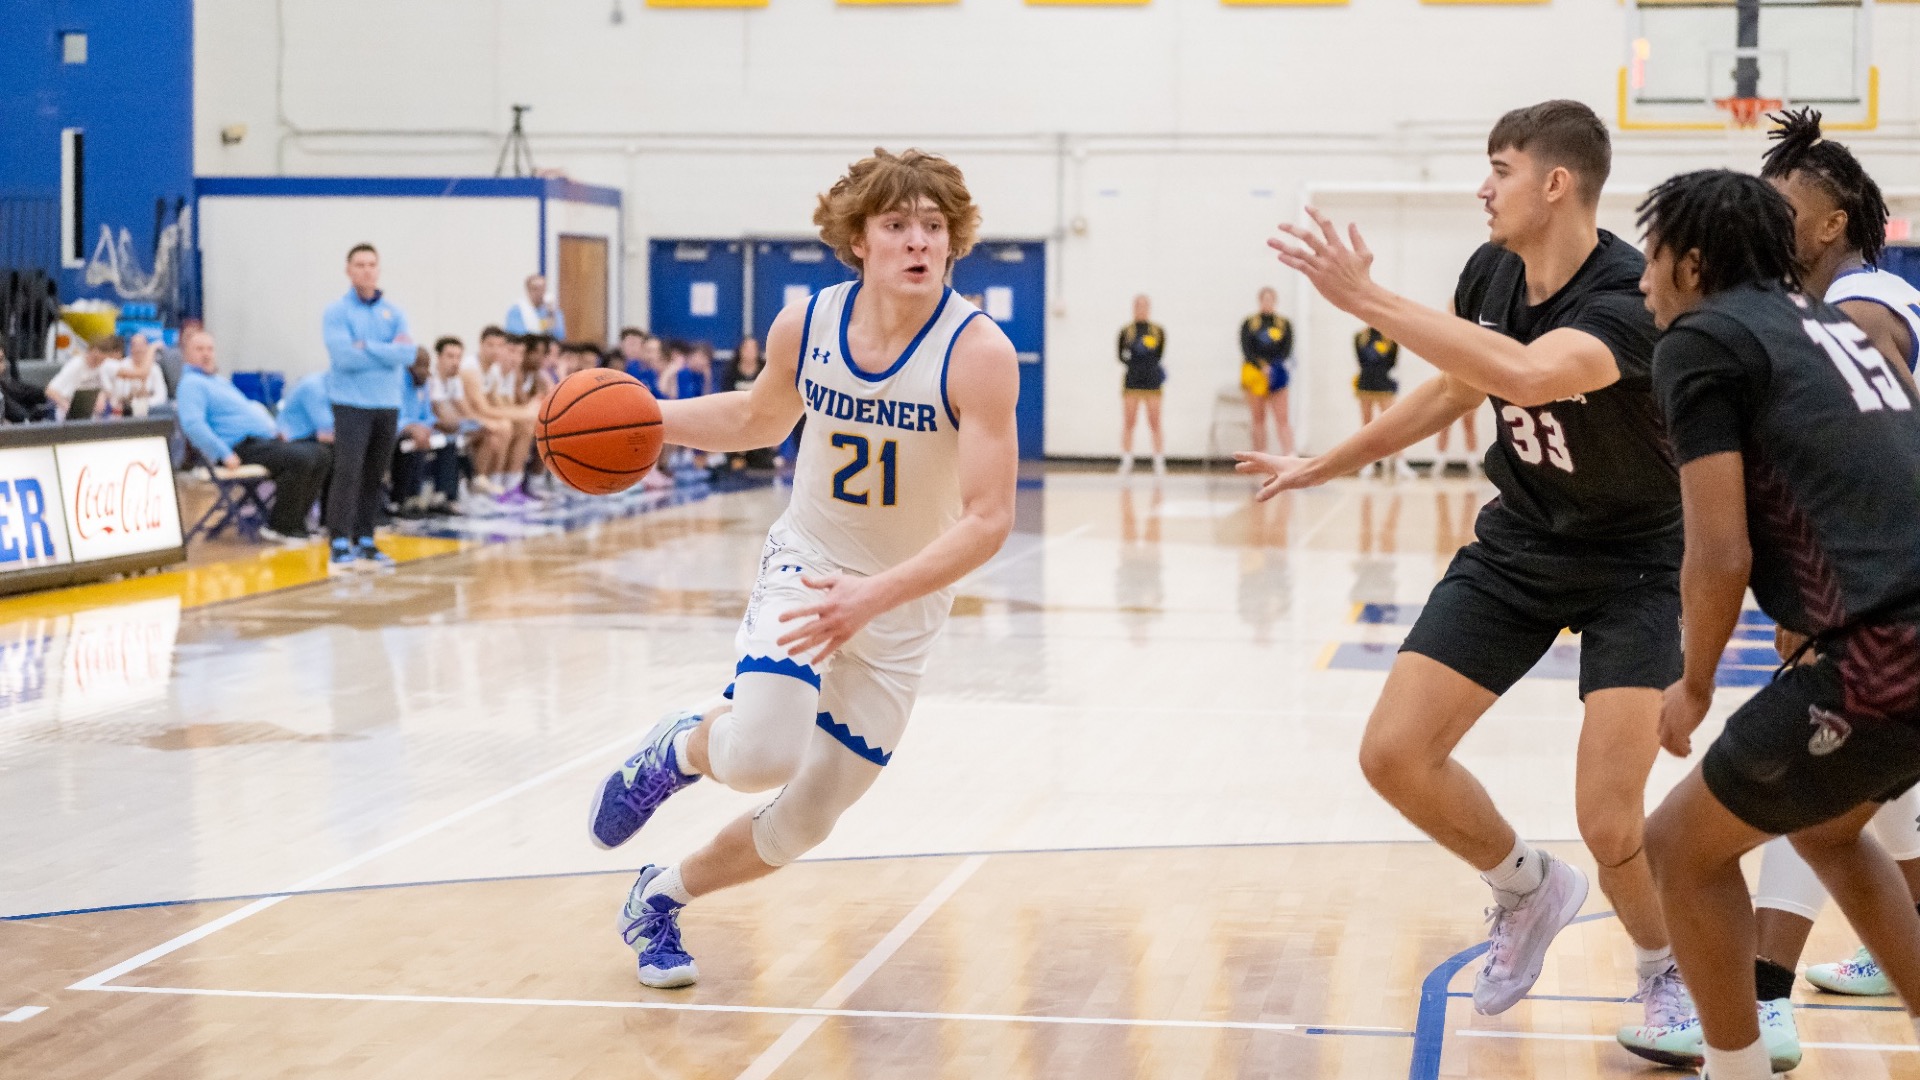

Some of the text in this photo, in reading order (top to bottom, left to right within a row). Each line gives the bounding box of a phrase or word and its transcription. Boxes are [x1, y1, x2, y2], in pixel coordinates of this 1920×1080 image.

[1802, 318, 1912, 413] 15
[804, 378, 938, 432] WIDENER
[1500, 404, 1575, 474] 33
[830, 431, 899, 508] 21
